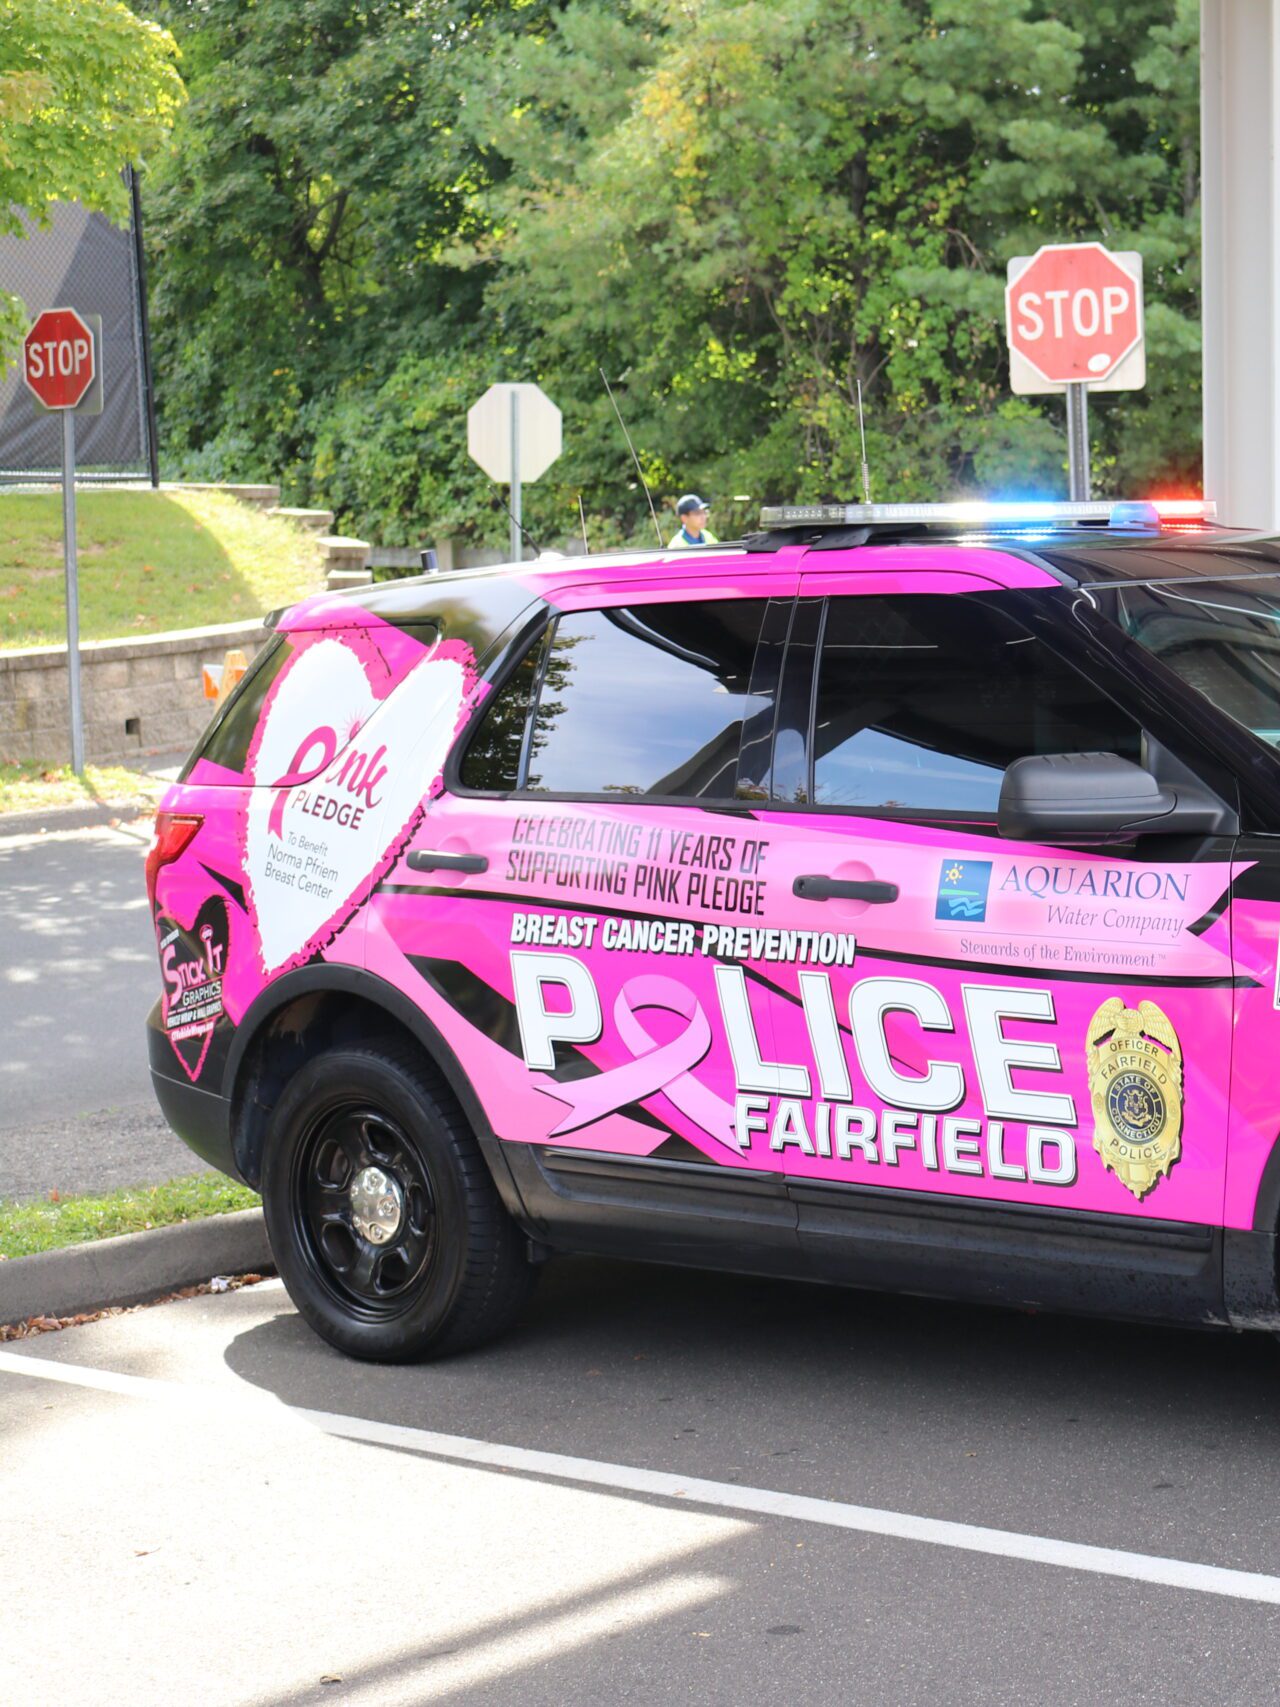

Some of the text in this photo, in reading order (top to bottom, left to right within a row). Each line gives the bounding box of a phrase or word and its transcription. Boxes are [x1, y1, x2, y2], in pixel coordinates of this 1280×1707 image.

[1017, 286, 1129, 341] STOP
[29, 339, 89, 378] STOP
[292, 790, 364, 830] PLEDGE
[267, 843, 339, 883] Norma Pfriem
[288, 831, 329, 857] To Benefit
[512, 813, 640, 858] CELEBRATING
[668, 831, 734, 873] YEARS
[740, 840, 769, 875] OF
[264, 861, 333, 900] Breast Center
[505, 849, 767, 915] SUPPORTING PINK PLEDGE
[1000, 864, 1192, 902] AQUARION
[510, 912, 856, 966] BREAST CANCER PREVENTION
[1047, 904, 1186, 938] Water Company
[960, 939, 1020, 958] Stewards
[1024, 944, 1039, 961] of
[1041, 945, 1060, 961] the
[182, 981, 222, 1006] GRAPHICS
[1110, 1040, 1159, 1056] OFFICER
[1101, 1056, 1167, 1086] FAIRFIELD
[1114, 1075, 1156, 1096] STATE OF
[735, 1094, 1077, 1184] FAIRFIELD
[1111, 1107, 1162, 1140] CONNECTICUT
[1110, 1138, 1162, 1160] POLICE
